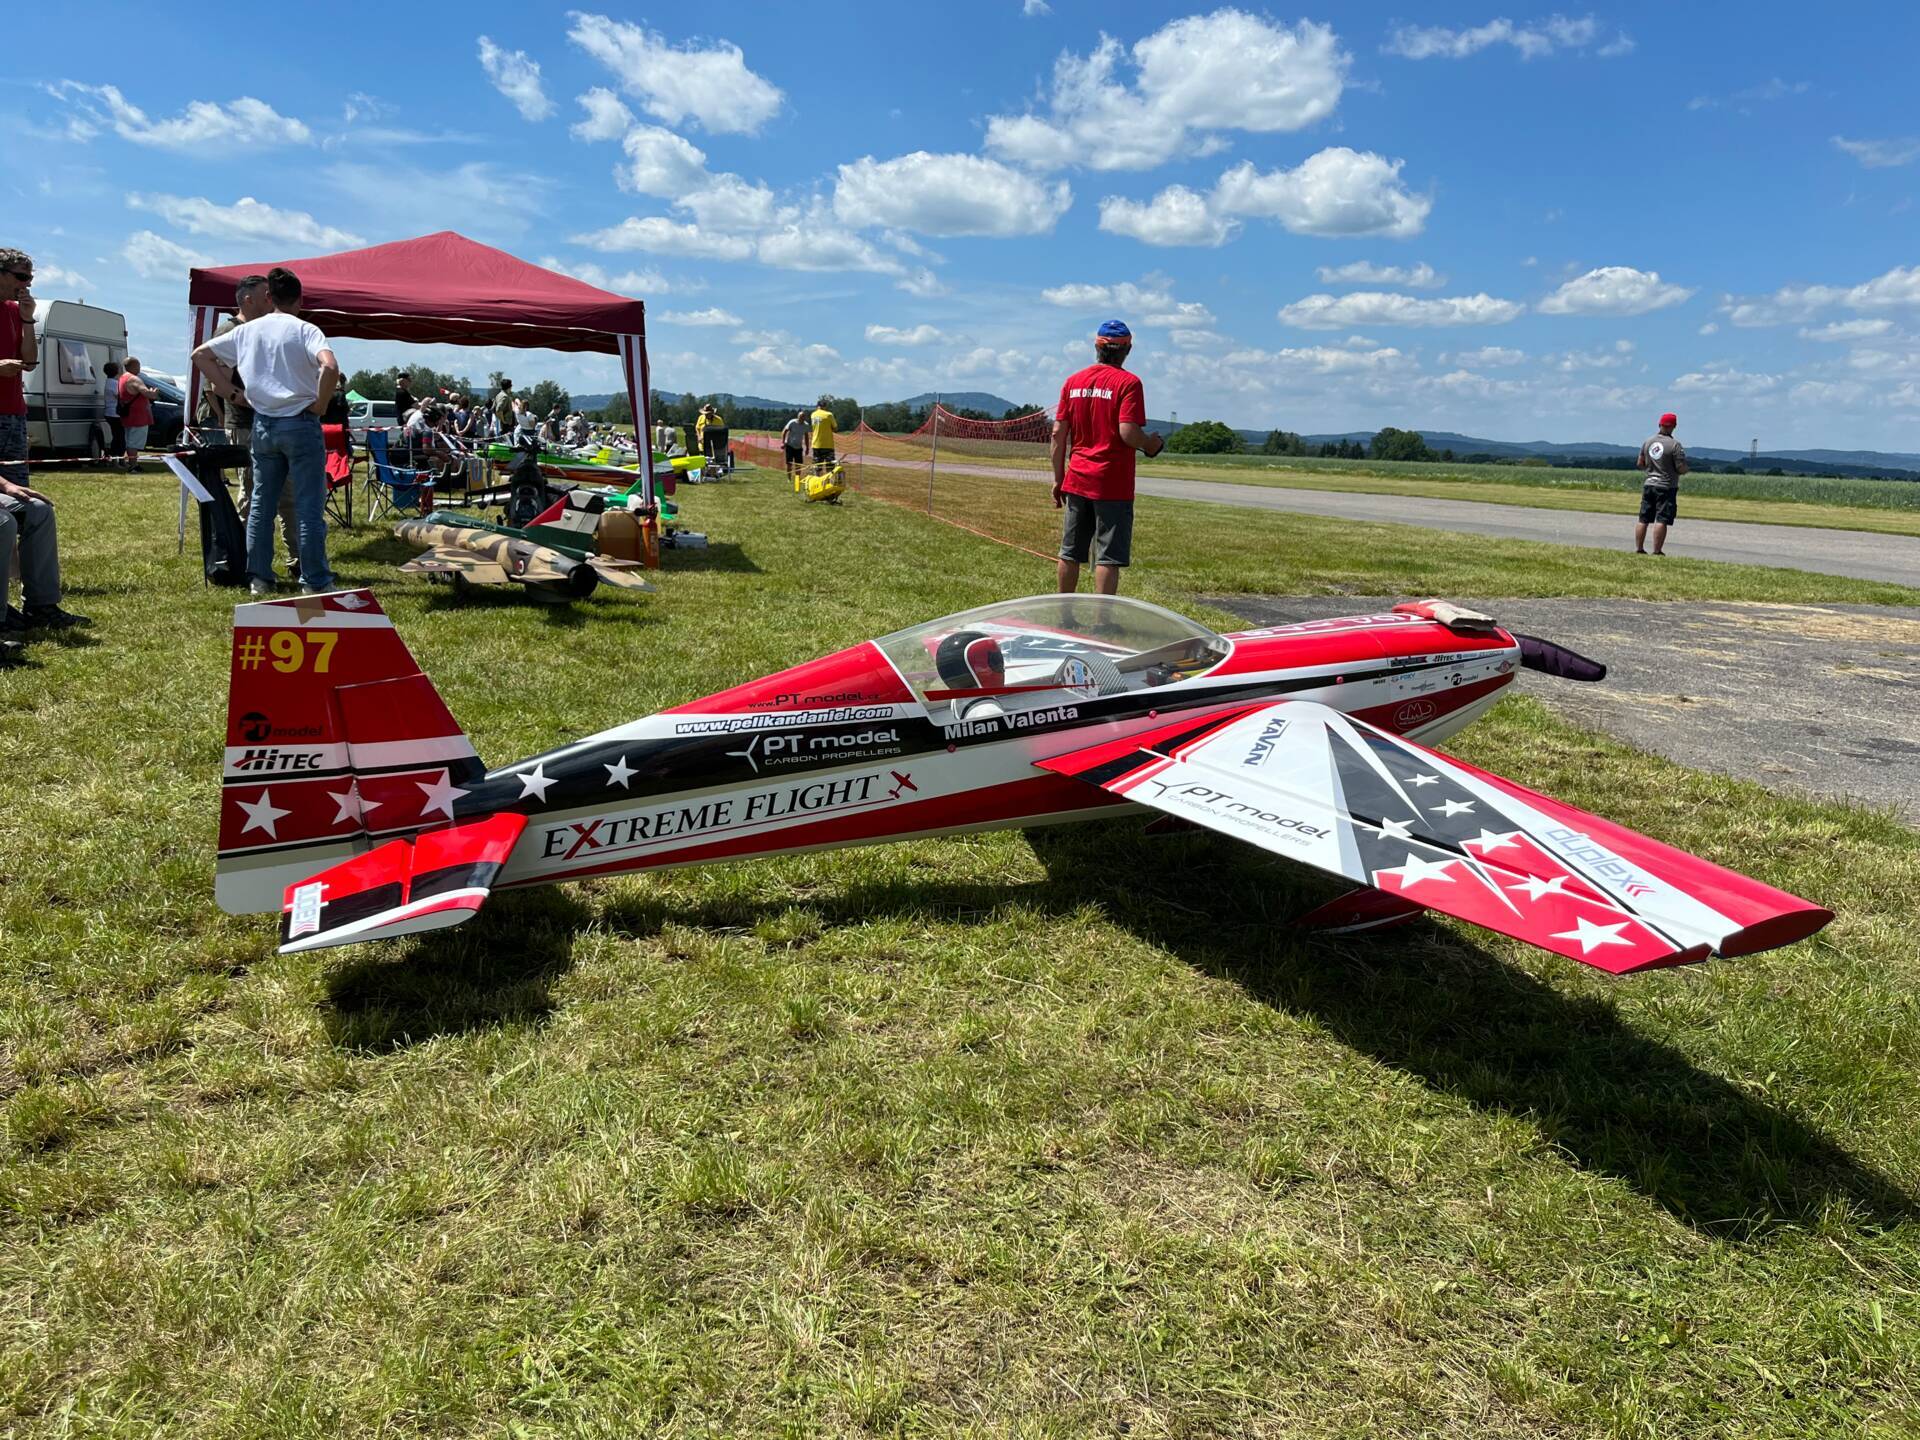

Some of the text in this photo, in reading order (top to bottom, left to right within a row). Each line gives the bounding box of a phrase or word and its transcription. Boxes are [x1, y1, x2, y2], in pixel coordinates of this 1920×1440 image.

[239, 631, 339, 673] #97
[273, 725, 323, 737] model
[676, 706, 893, 733] www.pelikandaniel.com
[945, 705, 1079, 740] Milan Valenta
[764, 729, 901, 755] PT model
[764, 747, 902, 766] CARBON PROPELLERS
[1243, 718, 1287, 766] KAVAN
[541, 775, 880, 860] EXTREME FLIGHT
[1167, 794, 1313, 847] CARBON PROPELLERS
[1180, 786, 1331, 839] PT model
[1545, 829, 1649, 888] duplex
